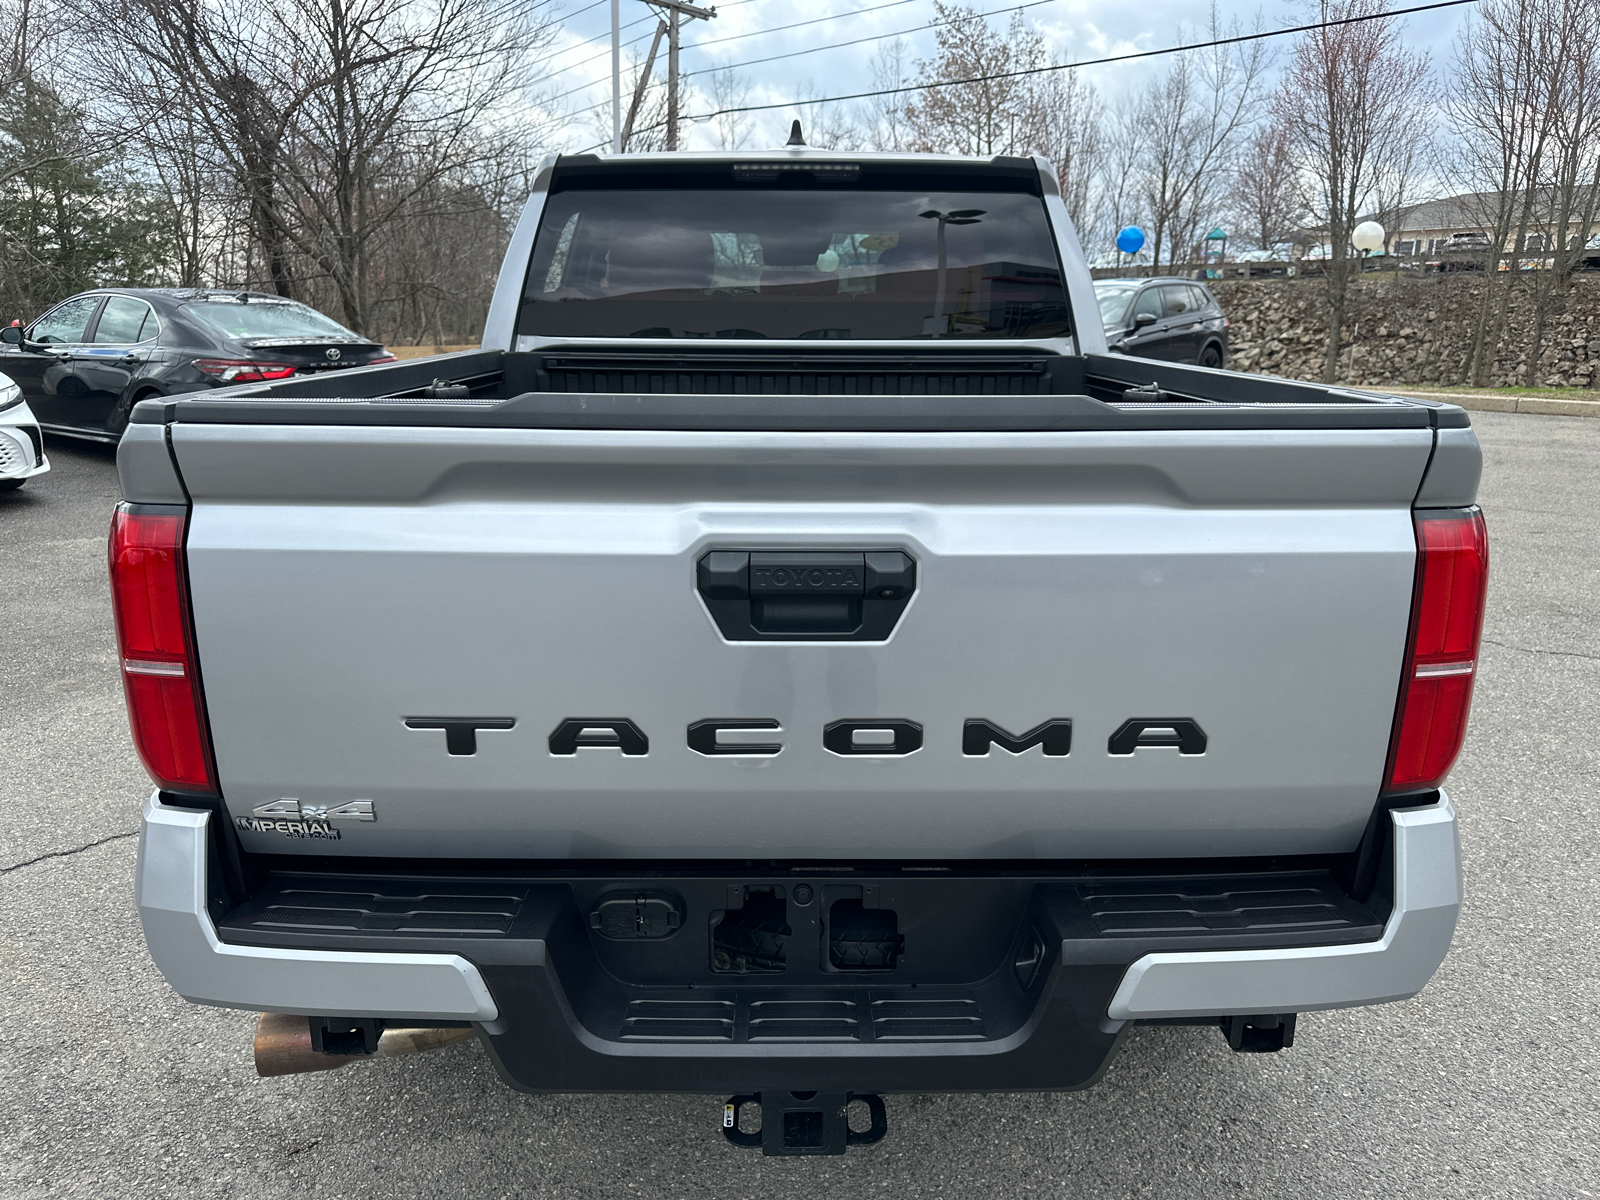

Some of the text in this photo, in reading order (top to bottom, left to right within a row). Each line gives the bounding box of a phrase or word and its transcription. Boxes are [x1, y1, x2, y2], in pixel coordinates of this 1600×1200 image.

[756, 568, 859, 587] TOYOTA
[403, 716, 1209, 758] TACOMA
[236, 817, 340, 836] IMPERIAL
